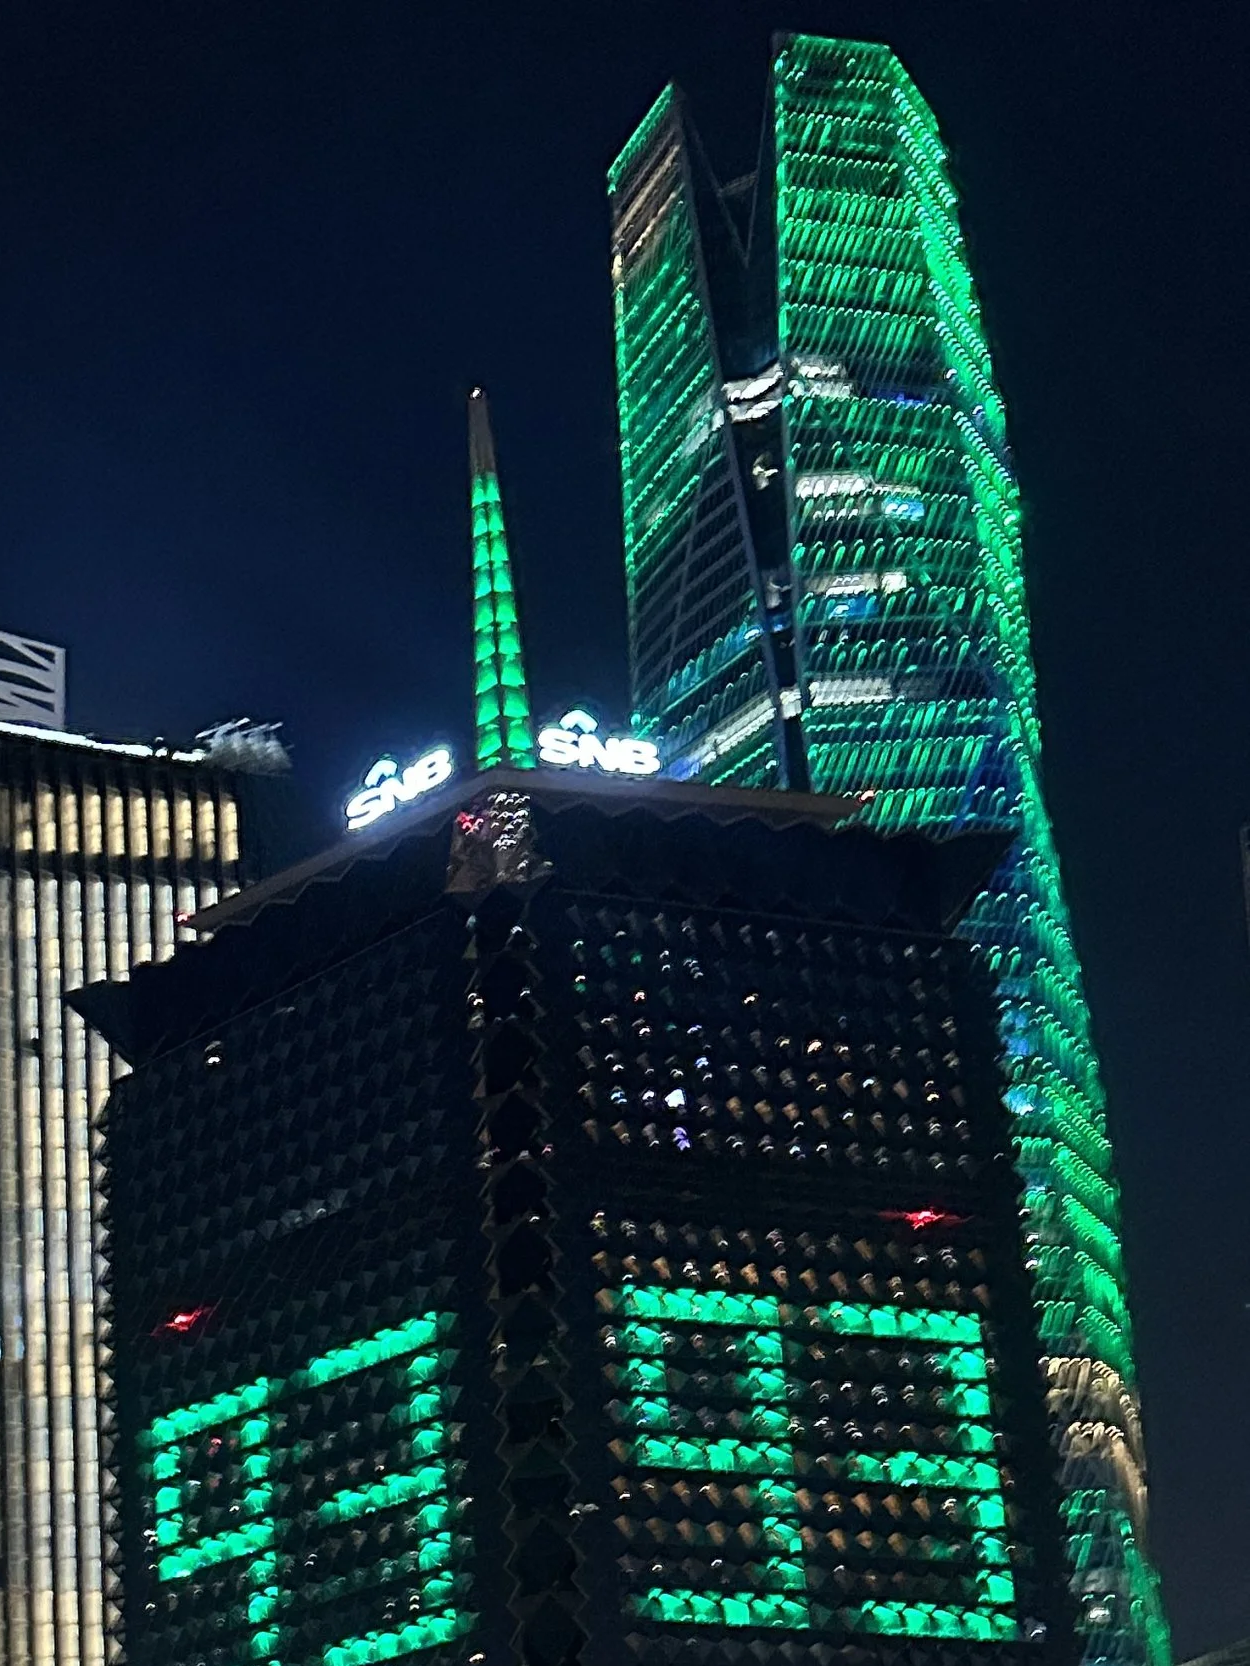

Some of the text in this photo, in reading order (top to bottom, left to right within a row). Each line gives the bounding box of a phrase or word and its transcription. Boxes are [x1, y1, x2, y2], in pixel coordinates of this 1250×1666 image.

[345, 748, 452, 831] SNB
[537, 726, 661, 776] SNB
[618, 1284, 1019, 1642] 93
